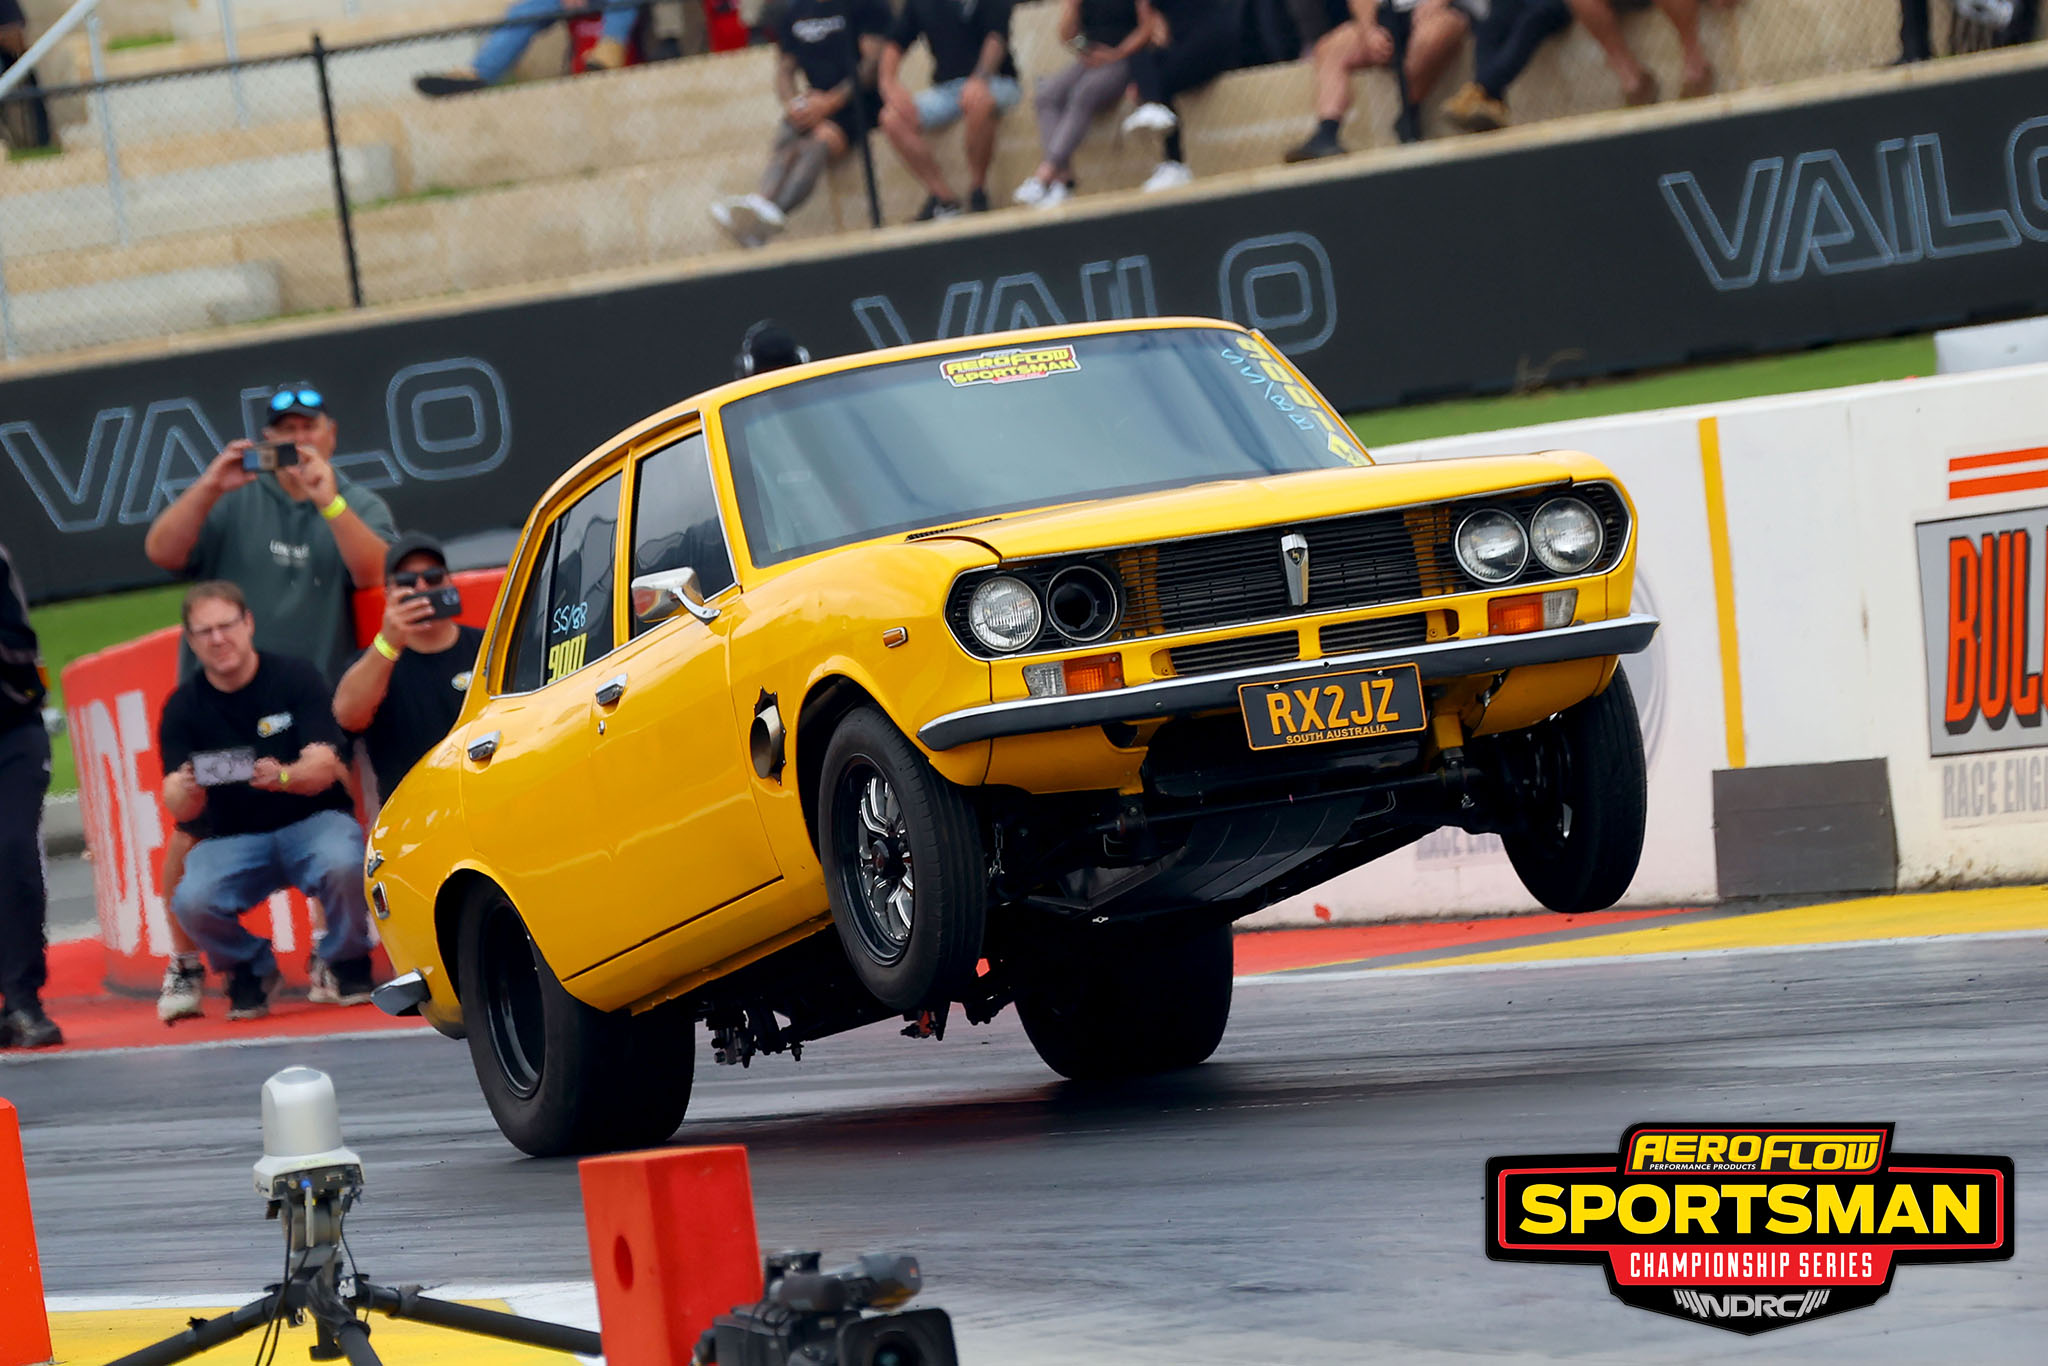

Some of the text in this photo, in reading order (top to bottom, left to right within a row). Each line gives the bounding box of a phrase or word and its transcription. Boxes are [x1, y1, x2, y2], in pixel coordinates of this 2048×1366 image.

[945, 348, 1070, 376] AEROFLOW
[952, 359, 1076, 385] SPORTSMAN
[552, 601, 589, 635] SS/88
[1944, 526, 2048, 736] BUL
[546, 632, 589, 685] 9001
[1265, 677, 1400, 736] RX2JZ
[1285, 723, 1389, 745] SOUTH AUSTRALIA
[1943, 760, 1998, 819] RACE
